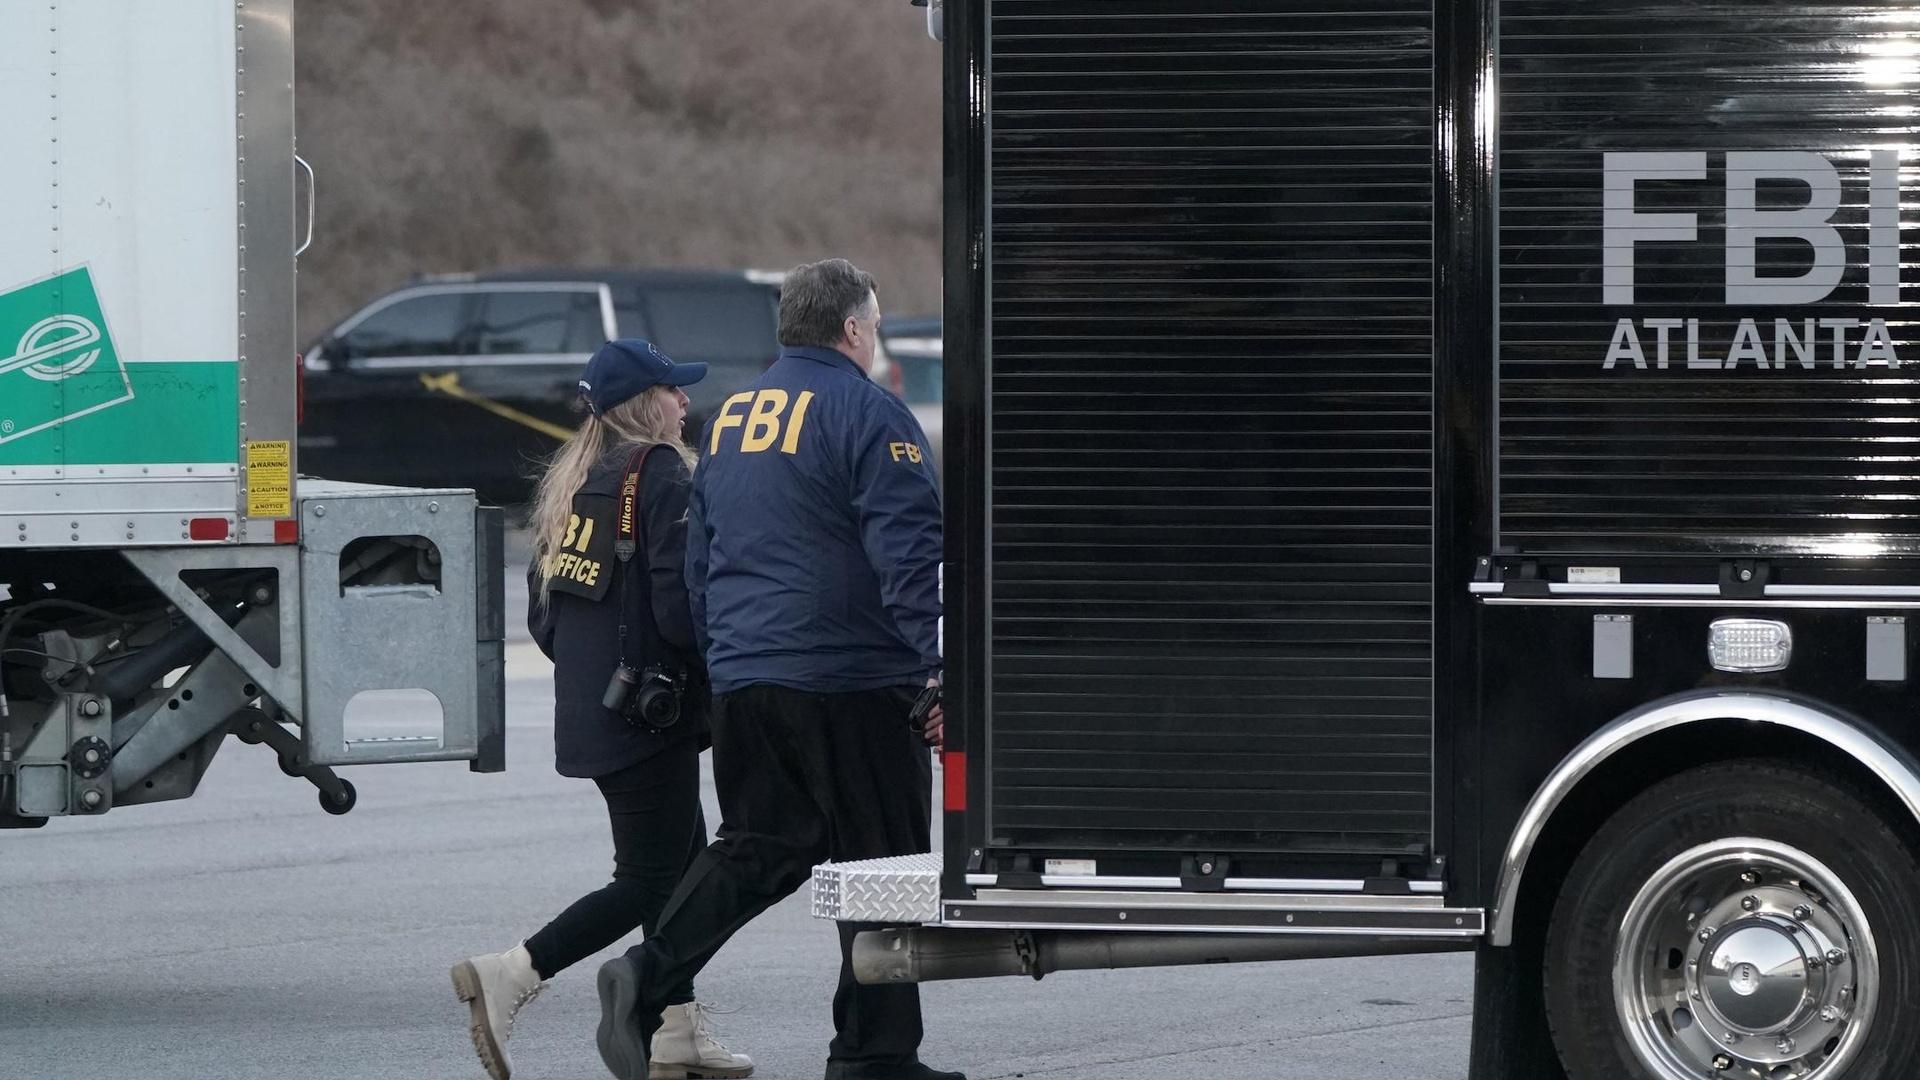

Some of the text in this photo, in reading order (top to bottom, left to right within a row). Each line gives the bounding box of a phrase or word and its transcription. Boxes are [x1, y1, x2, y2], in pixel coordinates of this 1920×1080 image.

[1603, 151, 1899, 304] FBI
[1602, 318, 1899, 369] ATLANTA
[710, 388, 815, 456] FBI
[561, 513, 595, 553] BI
[621, 497, 632, 533] Nikon
[551, 552, 601, 586] FFICE
